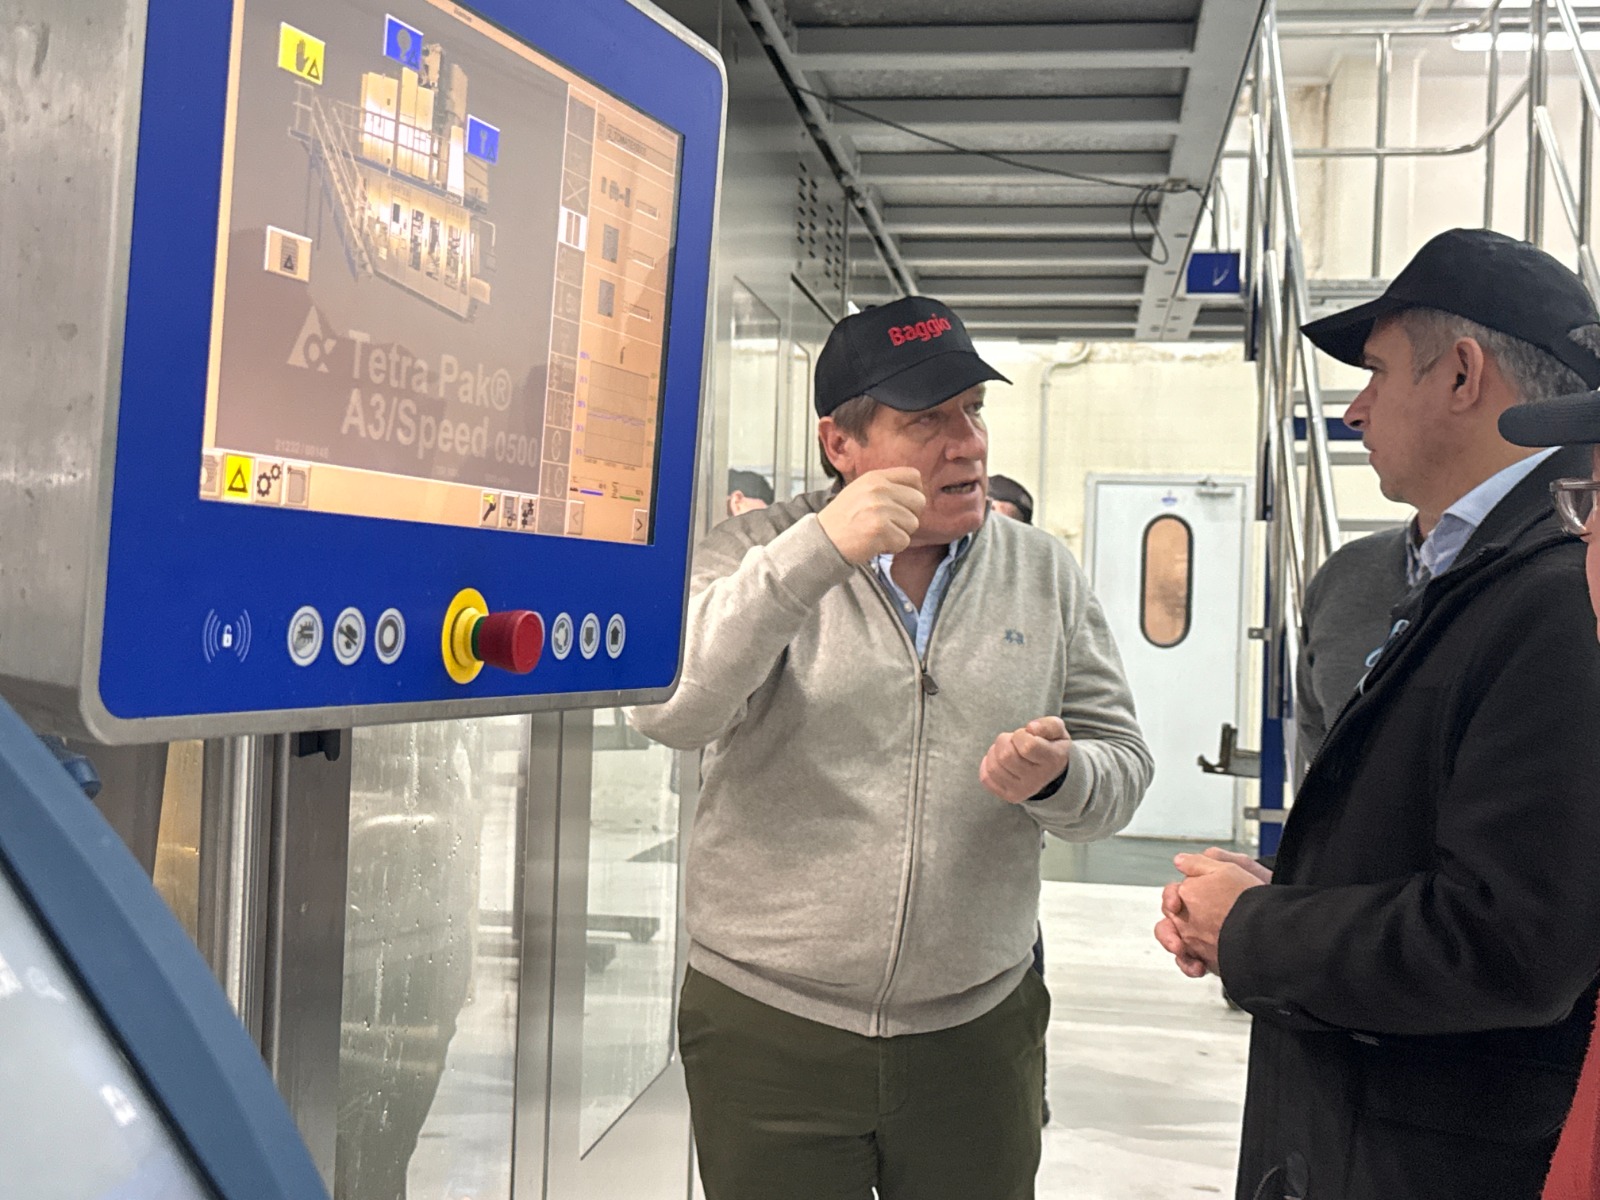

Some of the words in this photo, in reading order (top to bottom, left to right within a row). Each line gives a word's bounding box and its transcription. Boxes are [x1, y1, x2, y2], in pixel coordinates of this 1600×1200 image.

[349, 329, 429, 394] Tetra
[888, 313, 952, 346] Baggio
[340, 387, 489, 459] A3/Speed
[494, 431, 538, 467] 0500
